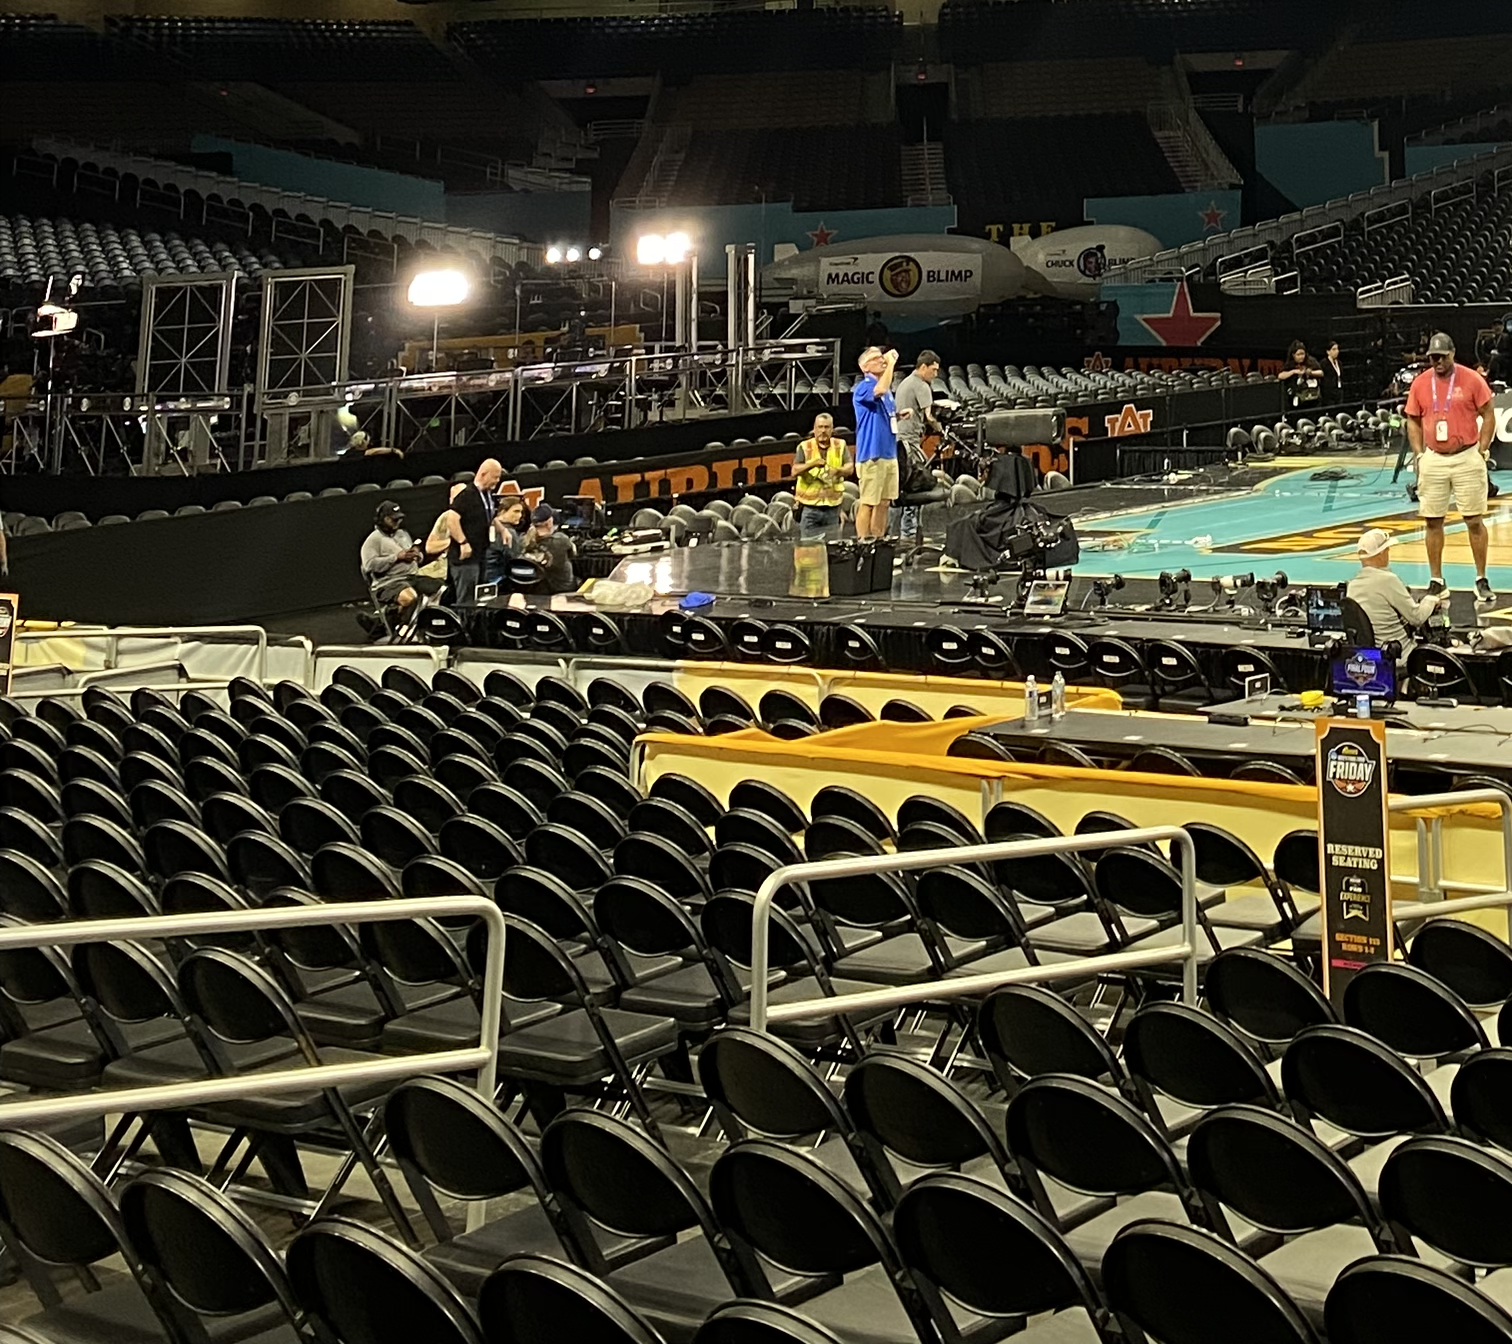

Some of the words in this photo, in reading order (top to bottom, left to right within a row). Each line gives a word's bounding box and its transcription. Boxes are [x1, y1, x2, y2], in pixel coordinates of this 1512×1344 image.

[1045, 259, 1075, 269] CHUCK
[826, 271, 875, 286] MAGIC
[926, 269, 974, 283] BLIMP
[1329, 760, 1373, 782] FRIDAY
[1326, 843, 1383, 860] RESERVED
[1331, 855, 1378, 870] SEATING
